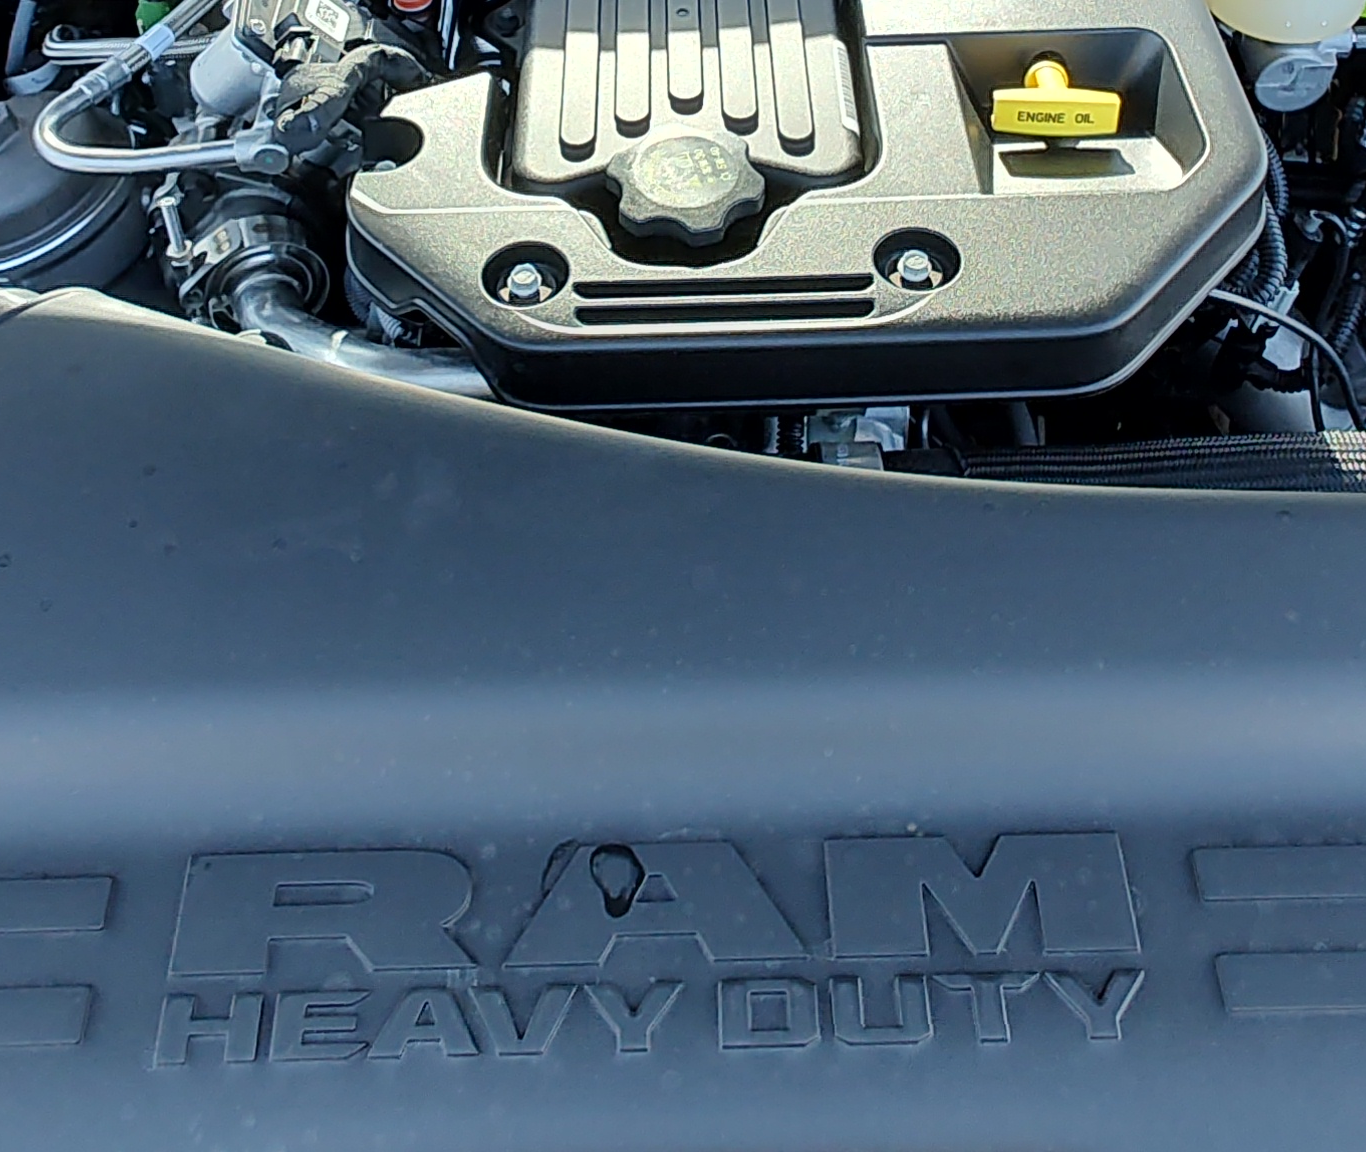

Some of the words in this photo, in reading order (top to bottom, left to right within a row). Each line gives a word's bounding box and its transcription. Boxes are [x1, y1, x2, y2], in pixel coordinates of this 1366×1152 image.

[1016, 110, 1066, 124] ENGINE
[1074, 112, 1095, 125] OIL
[167, 832, 1142, 976] RAM
[150, 982, 685, 1068] HEAVY
[718, 969, 1146, 1048] DUTY
